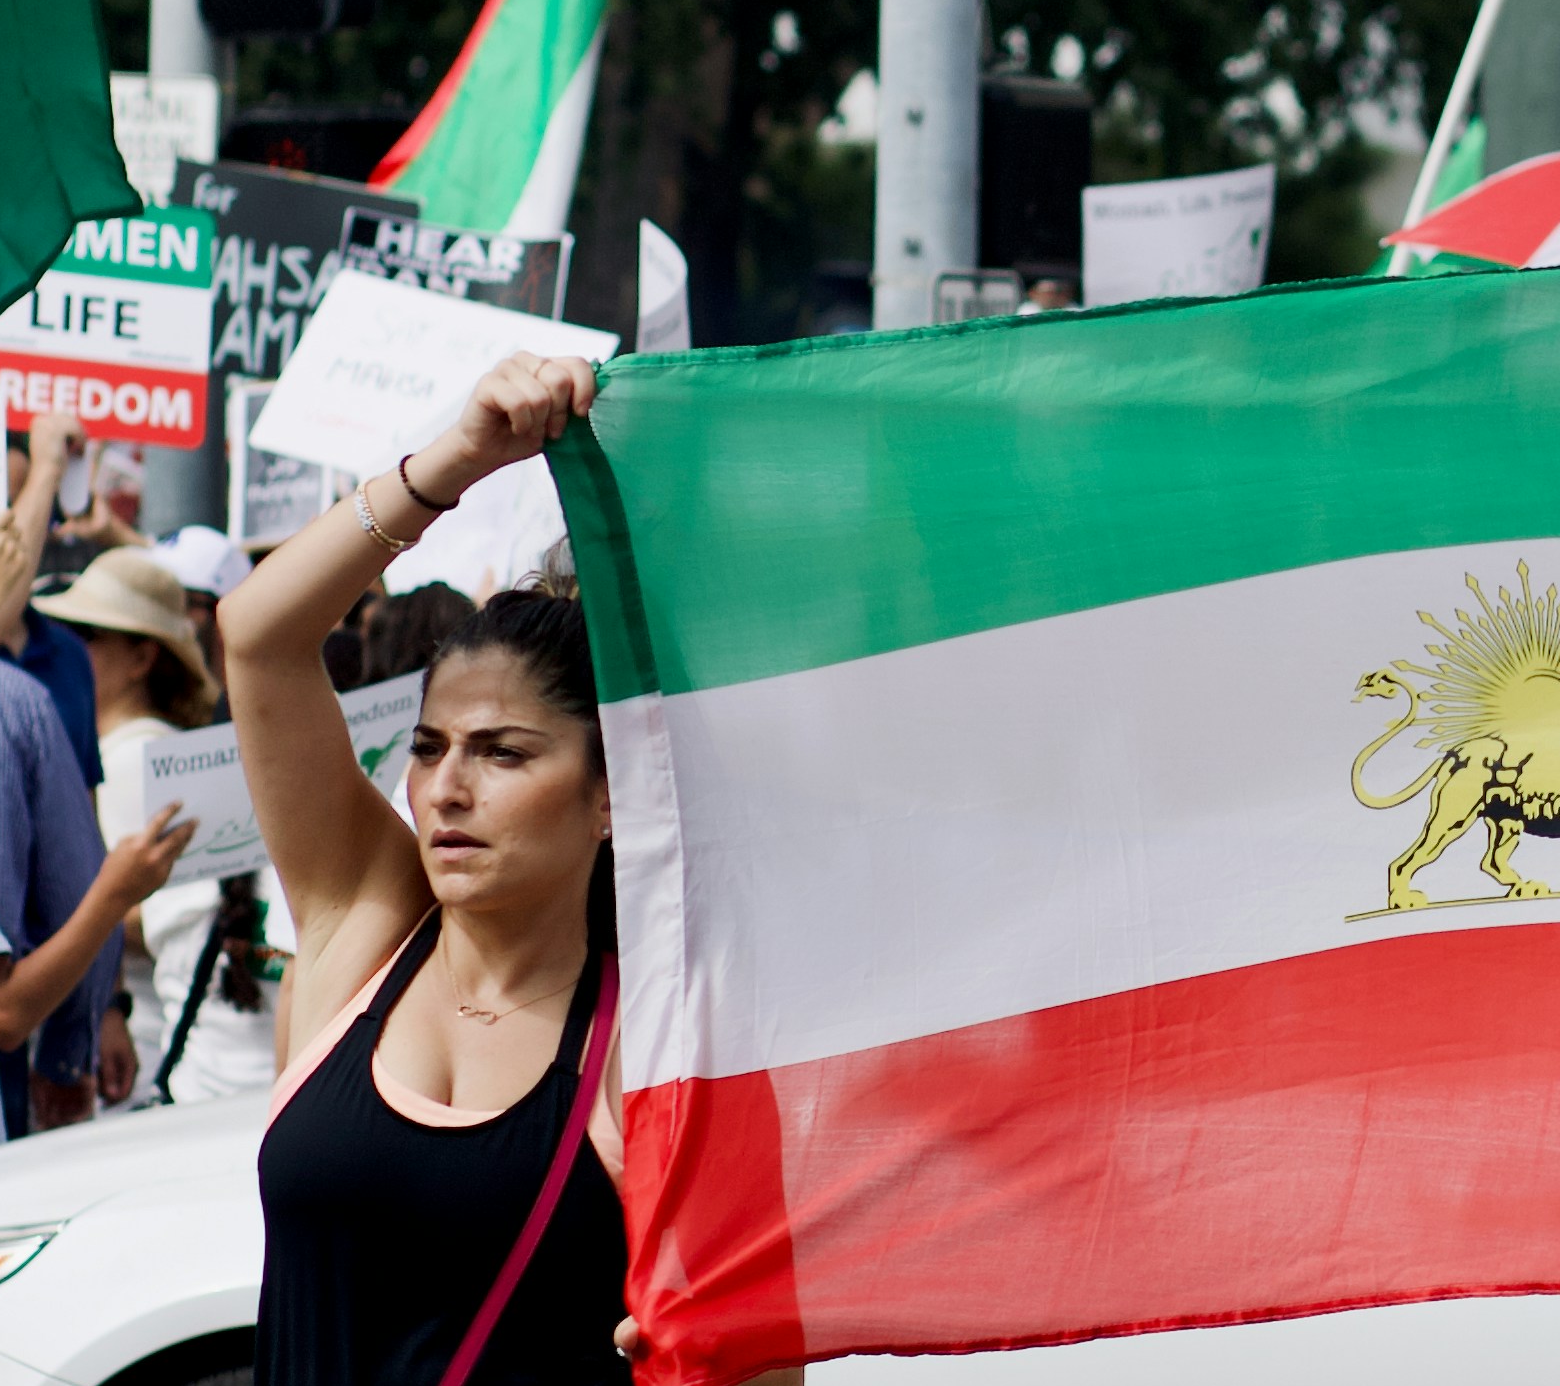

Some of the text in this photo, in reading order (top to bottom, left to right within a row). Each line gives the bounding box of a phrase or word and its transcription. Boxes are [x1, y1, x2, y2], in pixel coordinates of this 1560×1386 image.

[192, 171, 239, 217] for
[62, 217, 200, 273] MEN
[209, 233, 341, 310] AHSA
[375, 218, 525, 274] HEAR
[30, 289, 141, 341] LIFE
[211, 303, 314, 375] AM
[347, 694, 418, 727] eedom.
